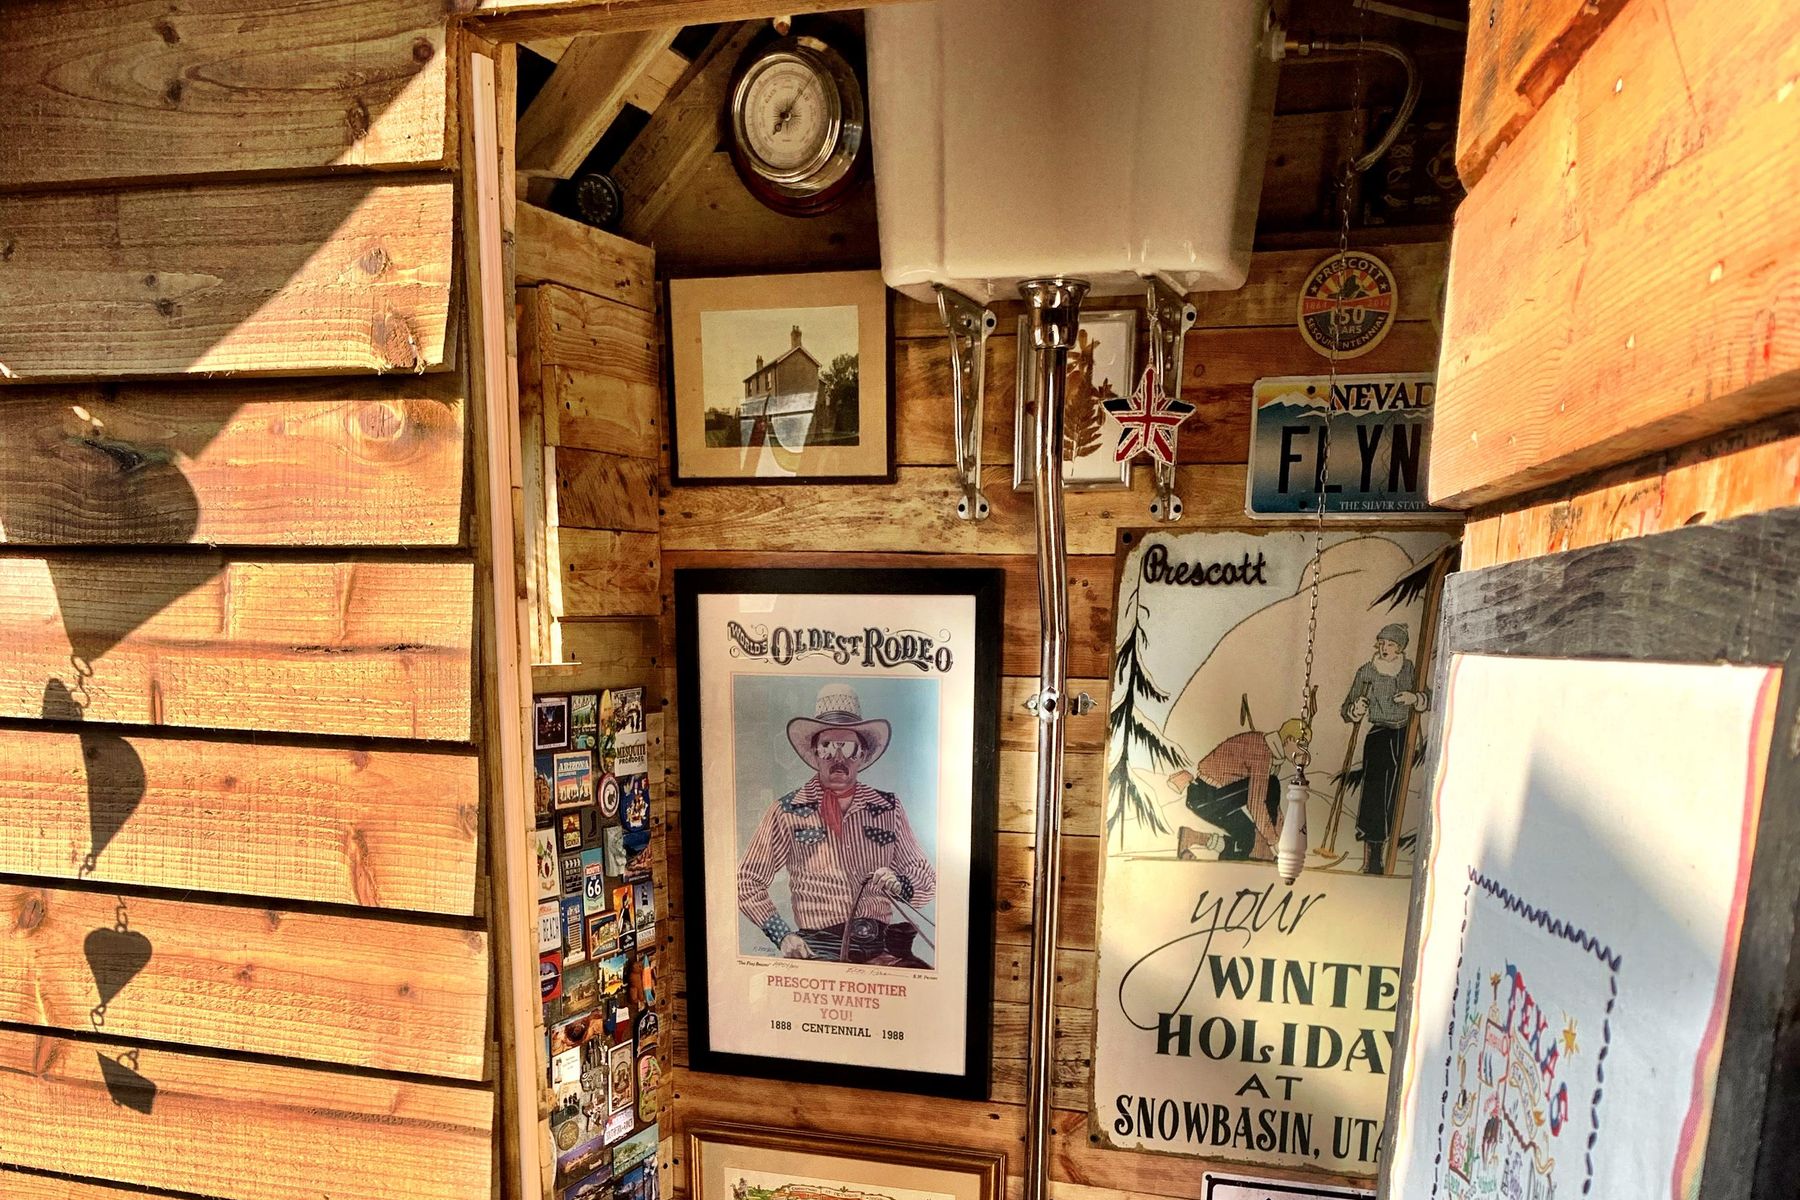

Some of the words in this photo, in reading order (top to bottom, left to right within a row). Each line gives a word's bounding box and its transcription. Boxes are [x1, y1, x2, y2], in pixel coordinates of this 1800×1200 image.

[1316, 258, 1384, 284] PRESCOTT
[1330, 305, 1366, 325] 150
[1328, 325, 1363, 335] YARS
[1278, 423, 1422, 494] FLYN
[1340, 500, 1360, 511] THE
[1361, 500, 1395, 511] SILVER
[1144, 544, 1267, 585] Prescott
[771, 627, 863, 665] OLDEST
[861, 627, 954, 672] RODEO
[616, 744, 646, 759] MESQUITE
[558, 759, 589, 772] ARIZONA
[587, 880, 601, 897] 66
[767, 975, 836, 991] PRESCOTT
[839, 981, 907, 998] FRONTIER
[793, 991, 829, 1005] DAYS
[831, 995, 880, 1010] WANTS
[819, 1008, 853, 1022] YOU!
[770, 1019, 792, 1031] 1888
[801, 1022, 872, 1038] CENTENNIAL
[882, 1029, 905, 1041] 1988
[1505, 958, 1569, 1137] TEXAS
[1235, 1073, 1303, 1101] AT
[1114, 1094, 1320, 1160] SNOWBASIN,
